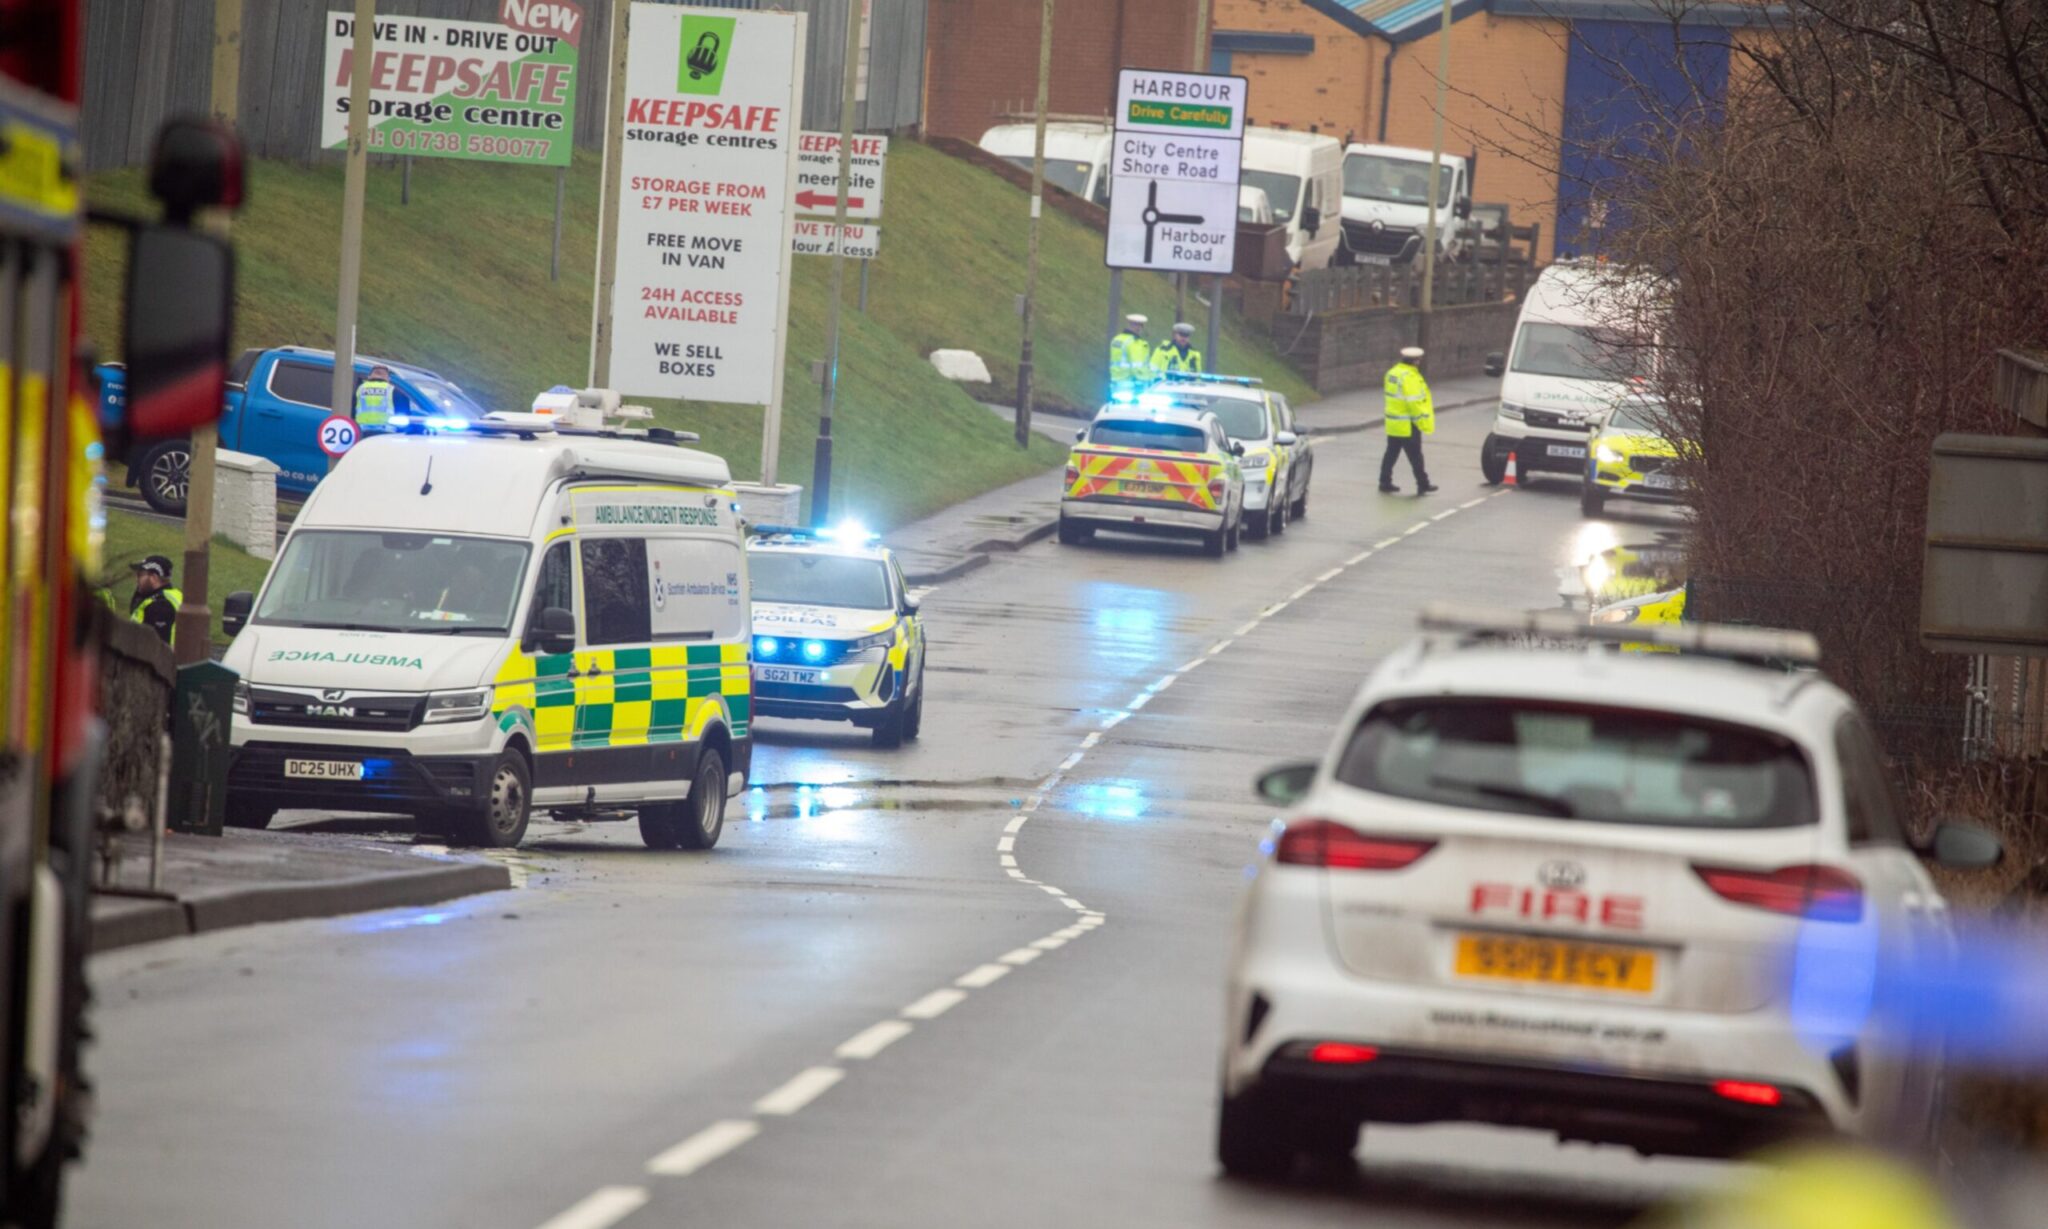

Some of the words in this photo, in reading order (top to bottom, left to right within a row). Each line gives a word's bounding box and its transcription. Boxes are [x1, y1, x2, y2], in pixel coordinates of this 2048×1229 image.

[503, 0, 579, 35] New
[335, 19, 397, 41] DVE
[404, 24, 426, 43] IN
[446, 28, 508, 51] DRIVE
[515, 34, 558, 54] OUT
[1132, 78, 1231, 101] HARBOUR
[336, 97, 452, 124] sorage
[464, 105, 563, 130] centre
[626, 97, 781, 133] KEEPSAFE
[1130, 103, 1164, 119] Drive
[1170, 106, 1229, 125] Carefully
[391, 130, 460, 151] 01738
[468, 136, 550, 160] 580077
[626, 128, 699, 147] storage
[706, 133, 778, 150] centres
[1123, 139, 1156, 158] City
[1164, 142, 1219, 160] Centre
[1121, 158, 1169, 176] Shore
[1177, 161, 1219, 179] Road
[631, 176, 711, 196] STORAGE
[716, 182, 766, 200] FROM
[641, 196, 663, 210] £7
[668, 197, 699, 213] PER
[702, 200, 752, 217] WEEK
[647, 232, 686, 249] FREE
[691, 236, 743, 253] MOVE
[1161, 227, 1226, 245] Harbour
[661, 251, 682, 267] IN
[687, 254, 726, 270] VAN
[1172, 244, 1213, 262] Road
[641, 286, 676, 302] 24H
[680, 289, 743, 307] ACCESS
[644, 305, 738, 325] AVAILABLE
[654, 341, 681, 357] WE
[686, 344, 723, 360] SELL
[658, 360, 716, 378] BOXES
[324, 427, 353, 446] 20
[595, 505, 643, 525] AMBULANCE
[643, 505, 677, 525] INCIDENT
[679, 506, 718, 527] RESPONSE
[763, 668, 790, 681] SG21
[306, 703, 355, 718] MAN
[289, 760, 326, 776] DC25
[328, 761, 356, 777] UHX
[1469, 882, 1645, 931] FIRE
